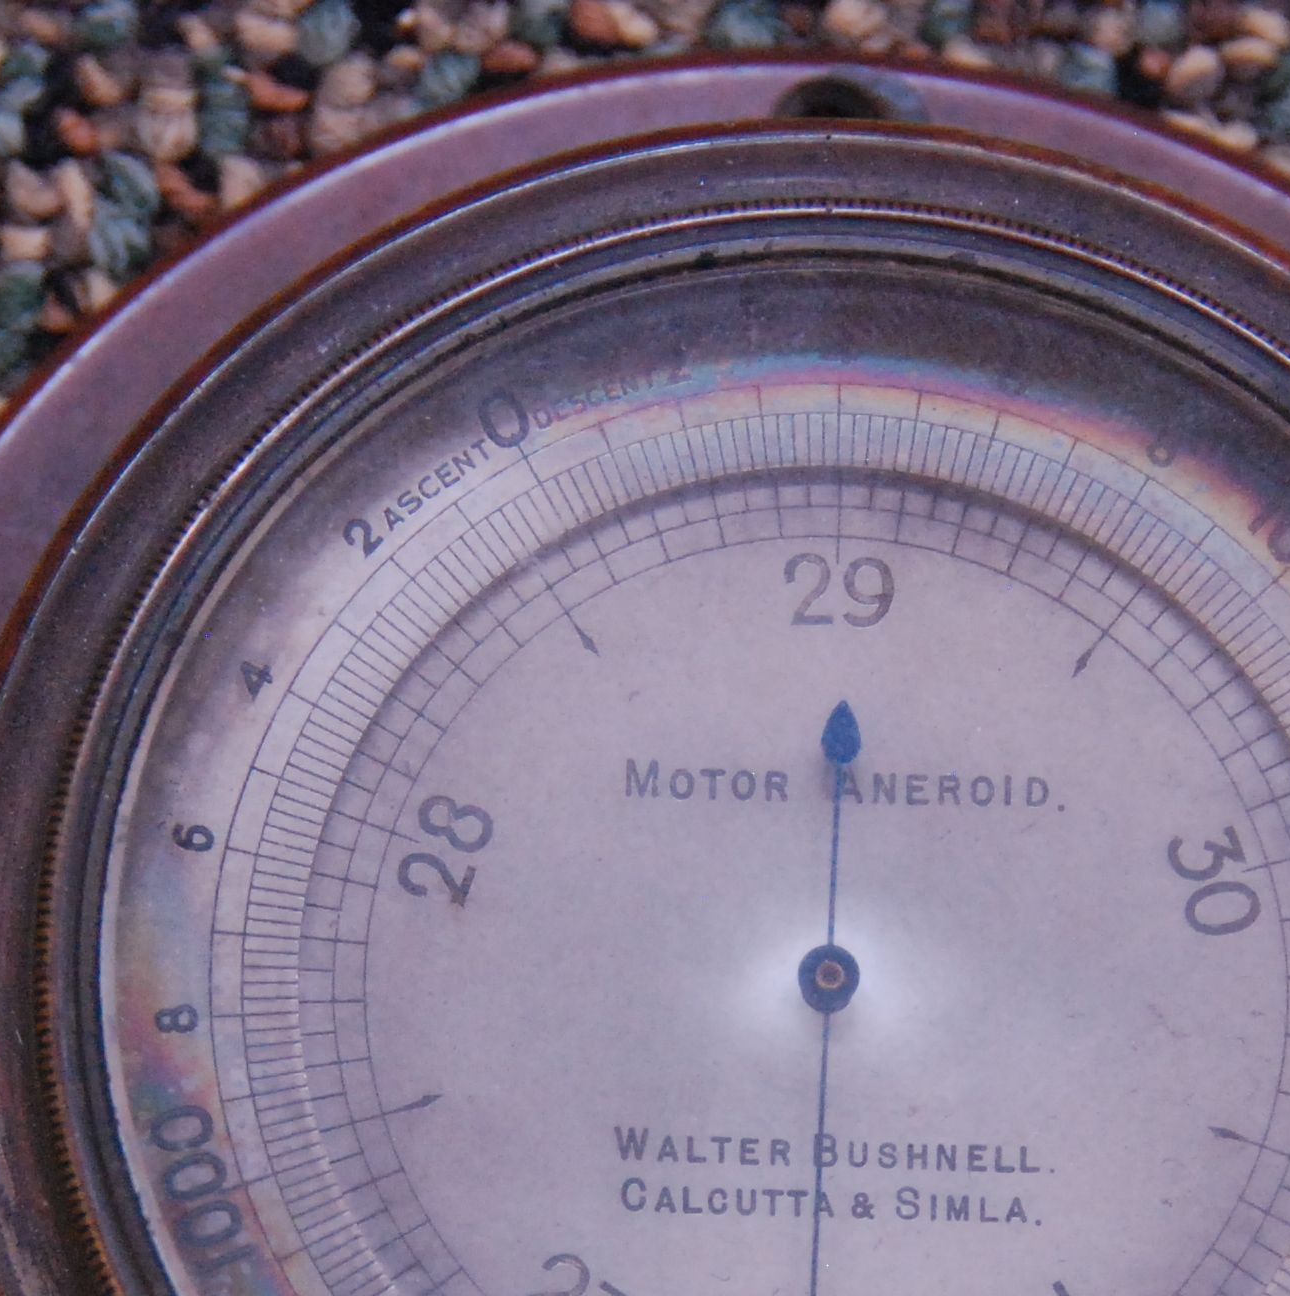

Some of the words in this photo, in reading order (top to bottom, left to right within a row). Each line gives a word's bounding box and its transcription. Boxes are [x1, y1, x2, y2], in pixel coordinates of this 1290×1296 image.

[383, 437, 490, 532] ASCENT
[342, 518, 385, 559] 2
[782, 551, 896, 629] 29
[239, 658, 275, 700] 4
[623, 757, 790, 803] MOTOR
[833, 769, 1067, 813] ANEROID.
[171, 821, 217, 853] 6
[396, 793, 495, 910] 28
[1166, 823, 1262, 938] 30
[153, 1003, 200, 1035] 8
[613, 1125, 792, 1167] WALTER
[813, 1132, 1057, 1175] BUSHNELL.
[619, 1176, 836, 1219] CALCUTTA
[851, 1191, 876, 1220] &
[894, 1186, 1044, 1227] SIMLA.
